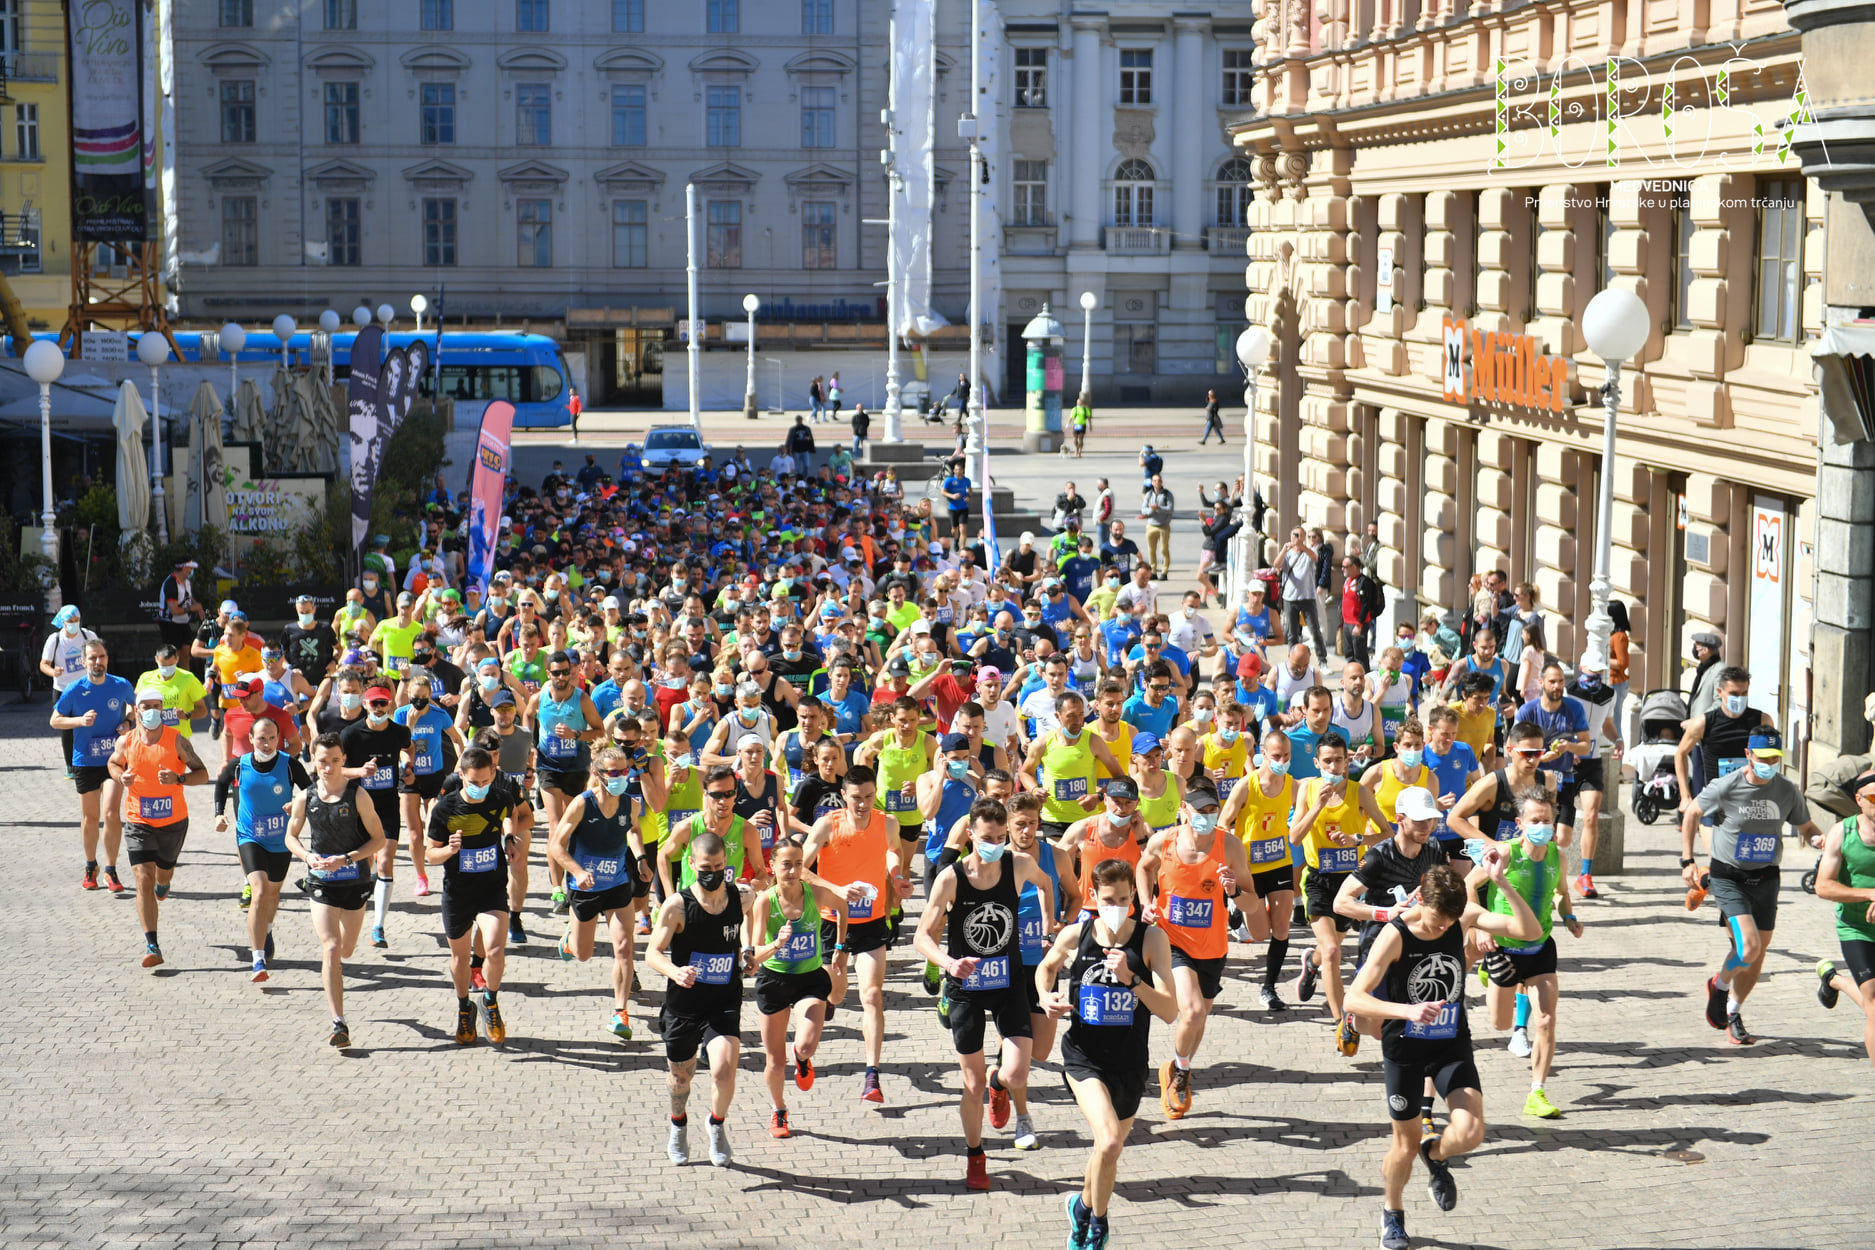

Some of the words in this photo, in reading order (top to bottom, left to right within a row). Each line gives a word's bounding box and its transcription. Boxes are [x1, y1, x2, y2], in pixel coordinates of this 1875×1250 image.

[75, 26, 129, 56] Vivo
[1448, 343, 1460, 378] M
[1471, 329, 1568, 413] Müller
[226, 492, 280, 505] OTVORI
[229, 518, 288, 531] ALKONU
[1762, 533, 1774, 563] M
[559, 739, 576, 750] 128
[415, 755, 432, 768] 481
[1068, 779, 1087, 792] 180
[152, 798, 171, 812] 470
[1738, 806, 1768, 814] NORTH
[267, 816, 285, 830] 191
[759, 827, 773, 841] 00
[1264, 838, 1285, 854] 564
[1753, 837, 1776, 852] 369
[475, 848, 497, 864] 563
[1335, 849, 1357, 862] 185
[597, 859, 618, 874] 455
[981, 904, 999, 922] A
[1186, 902, 1212, 918] 347
[791, 934, 815, 951] 421
[707, 957, 733, 973] 380
[981, 959, 1007, 978] 461
[1428, 955, 1448, 977] A
[1103, 991, 1132, 1011] 132
